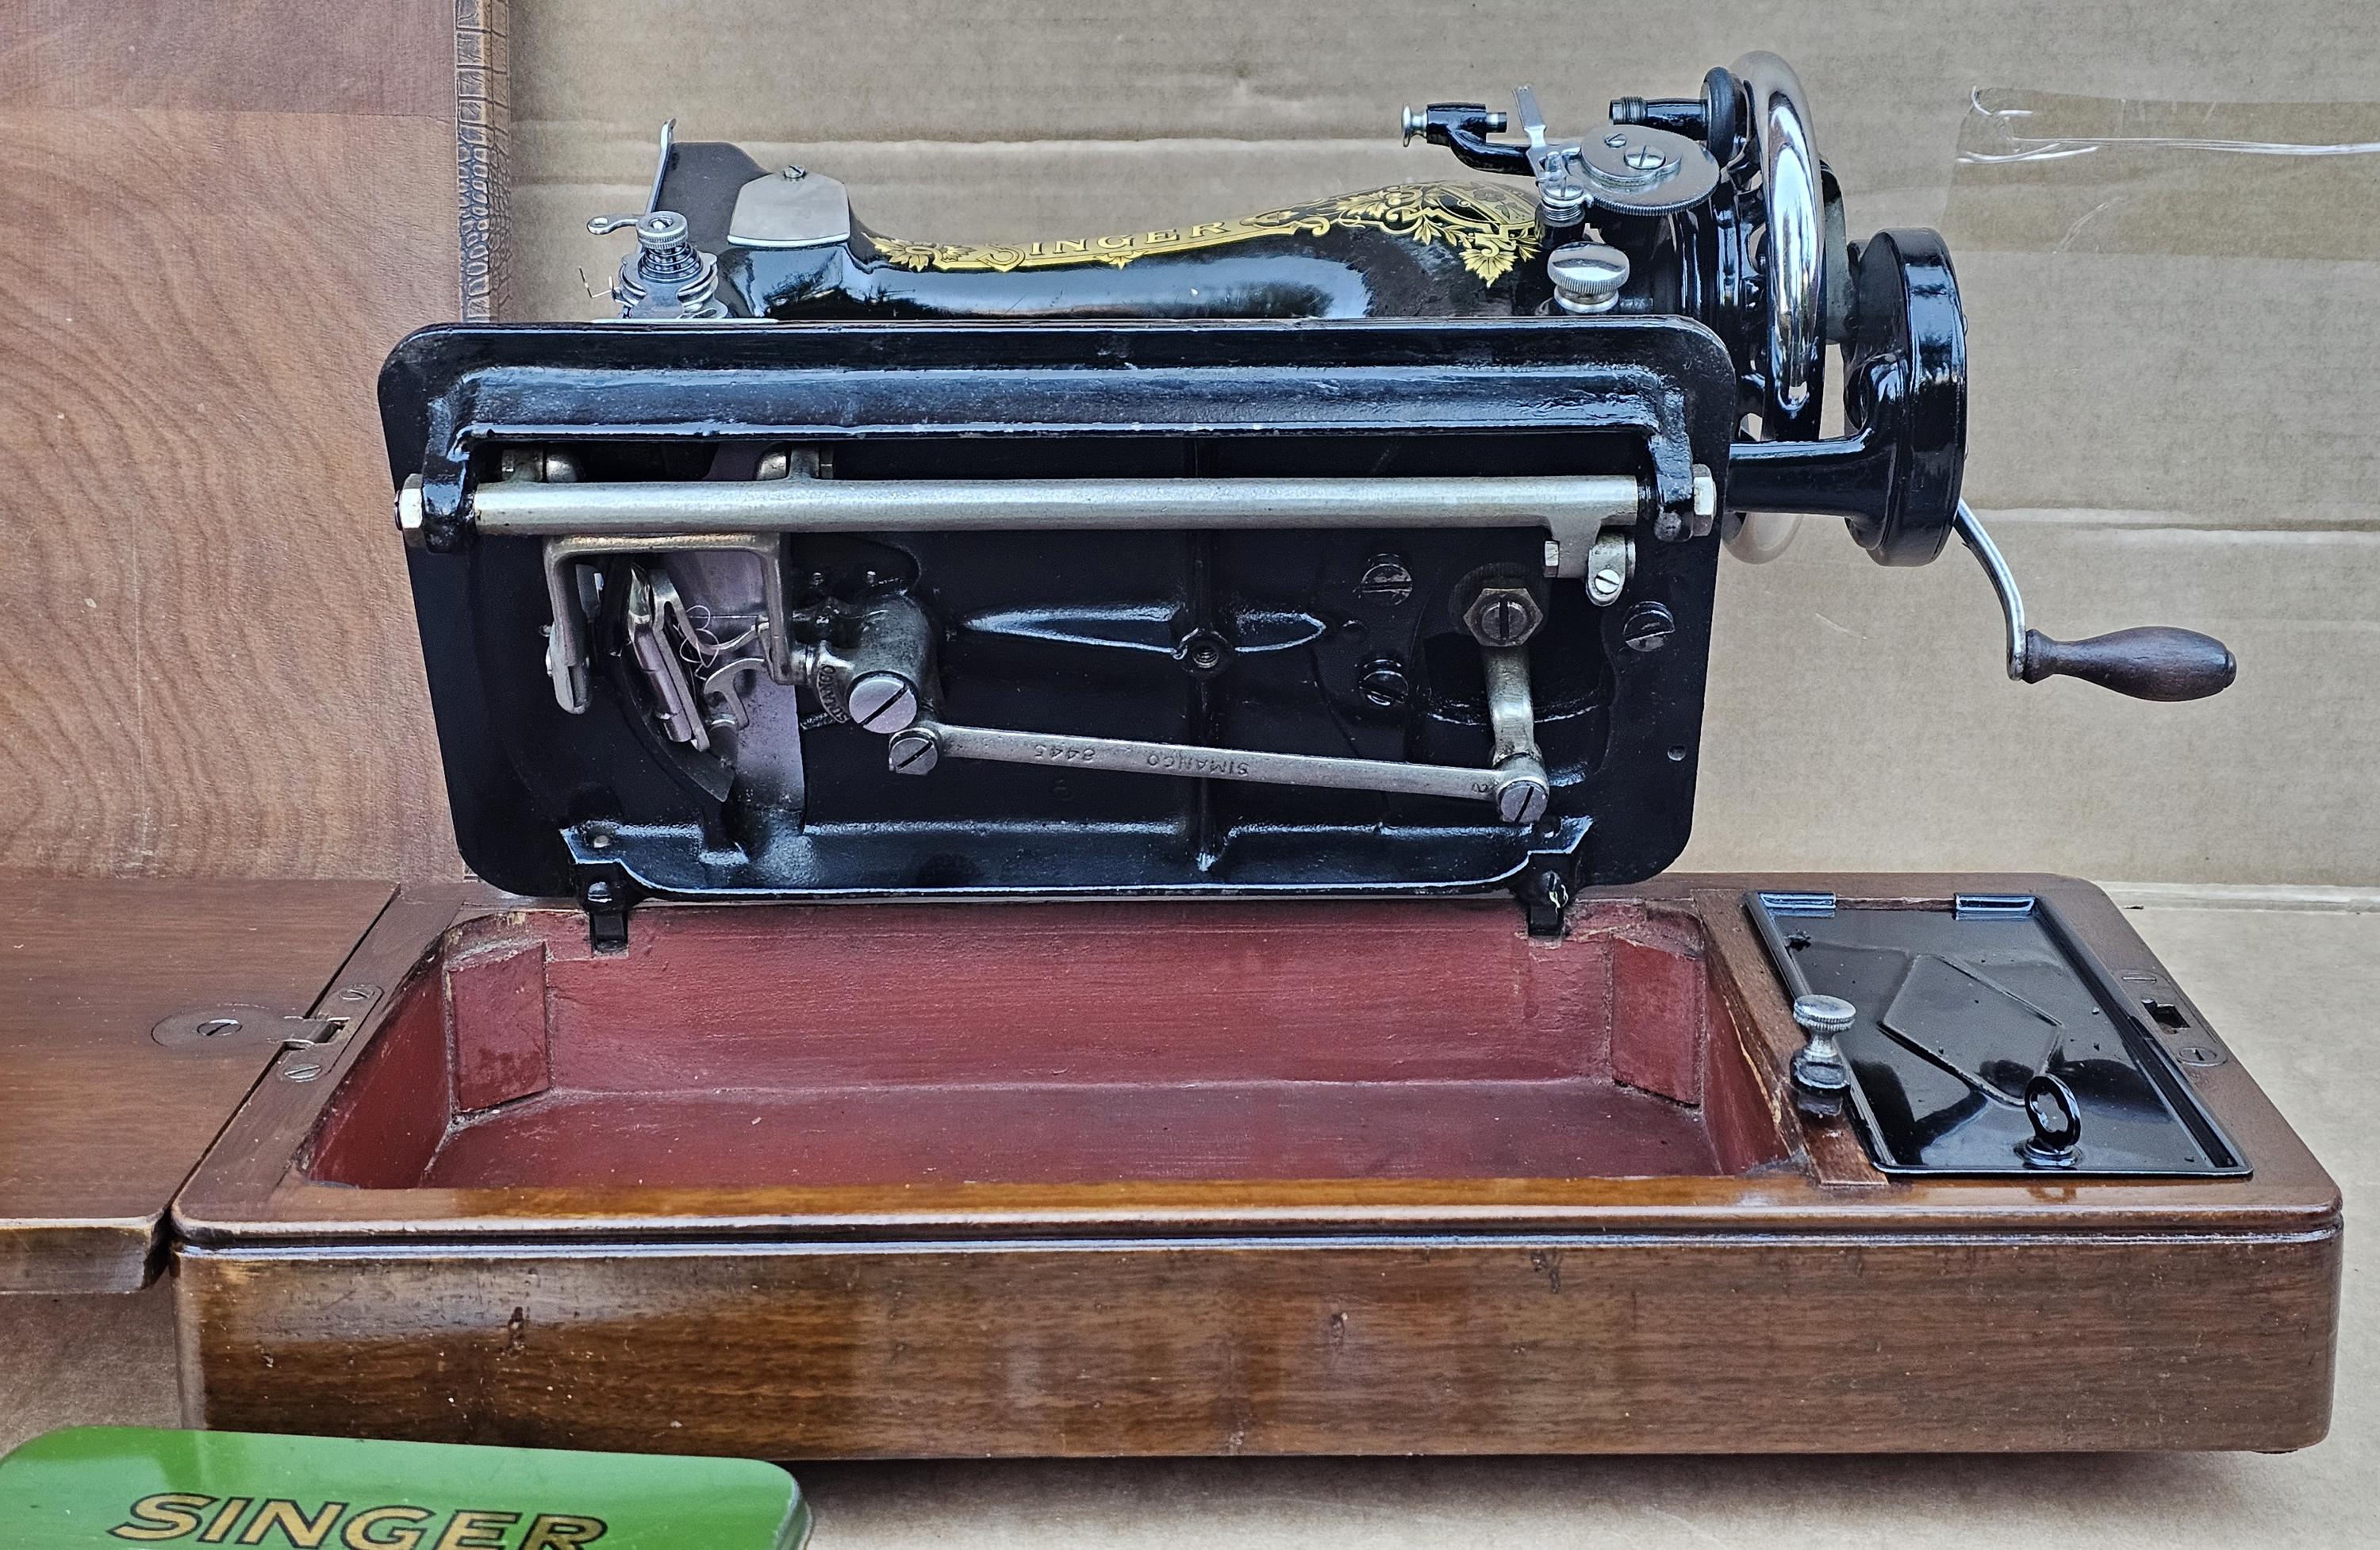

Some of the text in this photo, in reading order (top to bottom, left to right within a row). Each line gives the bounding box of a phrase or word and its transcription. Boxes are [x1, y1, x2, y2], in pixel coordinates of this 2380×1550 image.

[819, 664, 849, 721] SIMANCO
[1034, 743, 1250, 776] SIMANCO 8445
[106, 1492, 608, 1550] SINGER
